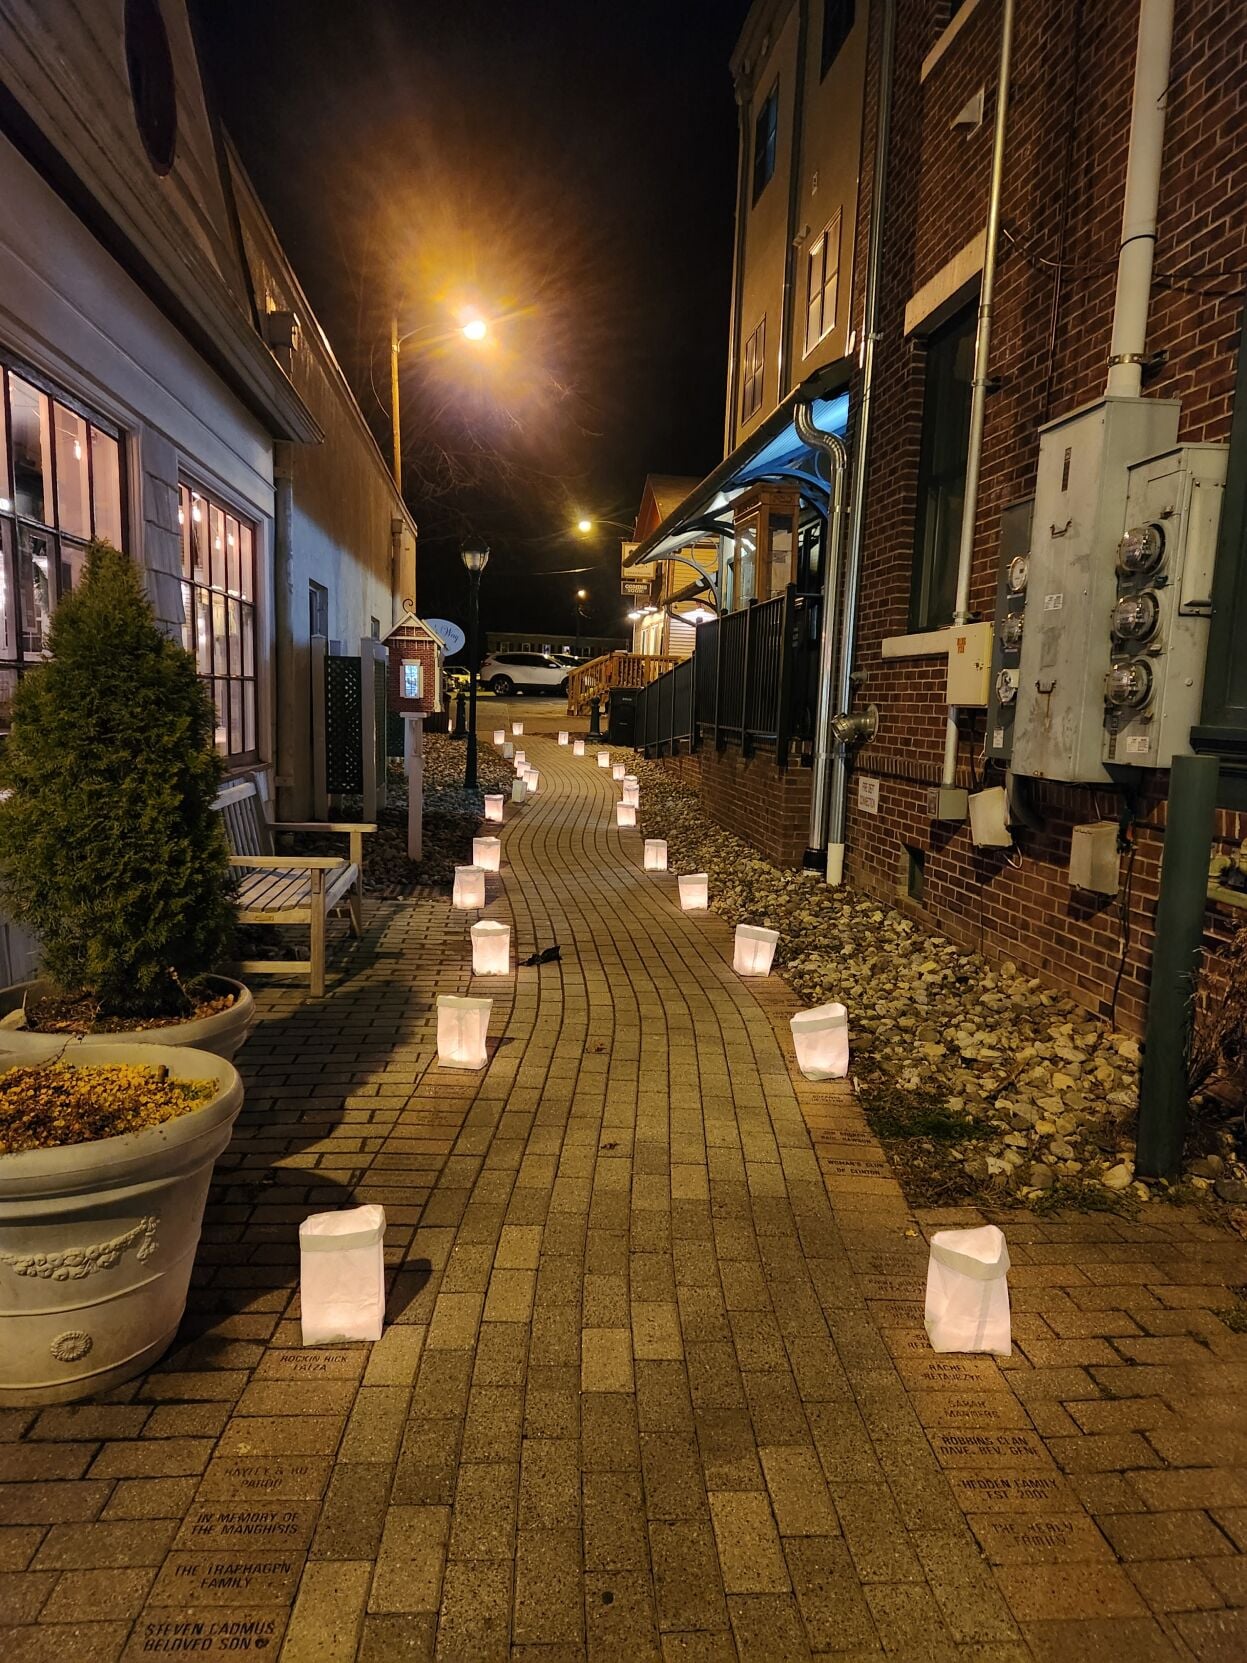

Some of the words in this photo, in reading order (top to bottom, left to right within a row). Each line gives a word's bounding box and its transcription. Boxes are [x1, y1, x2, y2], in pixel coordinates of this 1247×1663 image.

[942, 1436, 993, 1446] ROBBINS
[1015, 1479, 1057, 1489] FAMILY
[197, 1512, 215, 1523] IN
[218, 1512, 277, 1523] MEMORY
[283, 1512, 300, 1523] OF
[191, 1524, 215, 1535] THE
[175, 1565, 201, 1577] THE
[200, 1577, 252, 1589] FAMILY
[144, 1622, 203, 1637] STEVEN
[209, 1621, 276, 1636] CADMUS
[143, 1637, 213, 1652] BELOVED
[218, 1637, 252, 1651] SON
